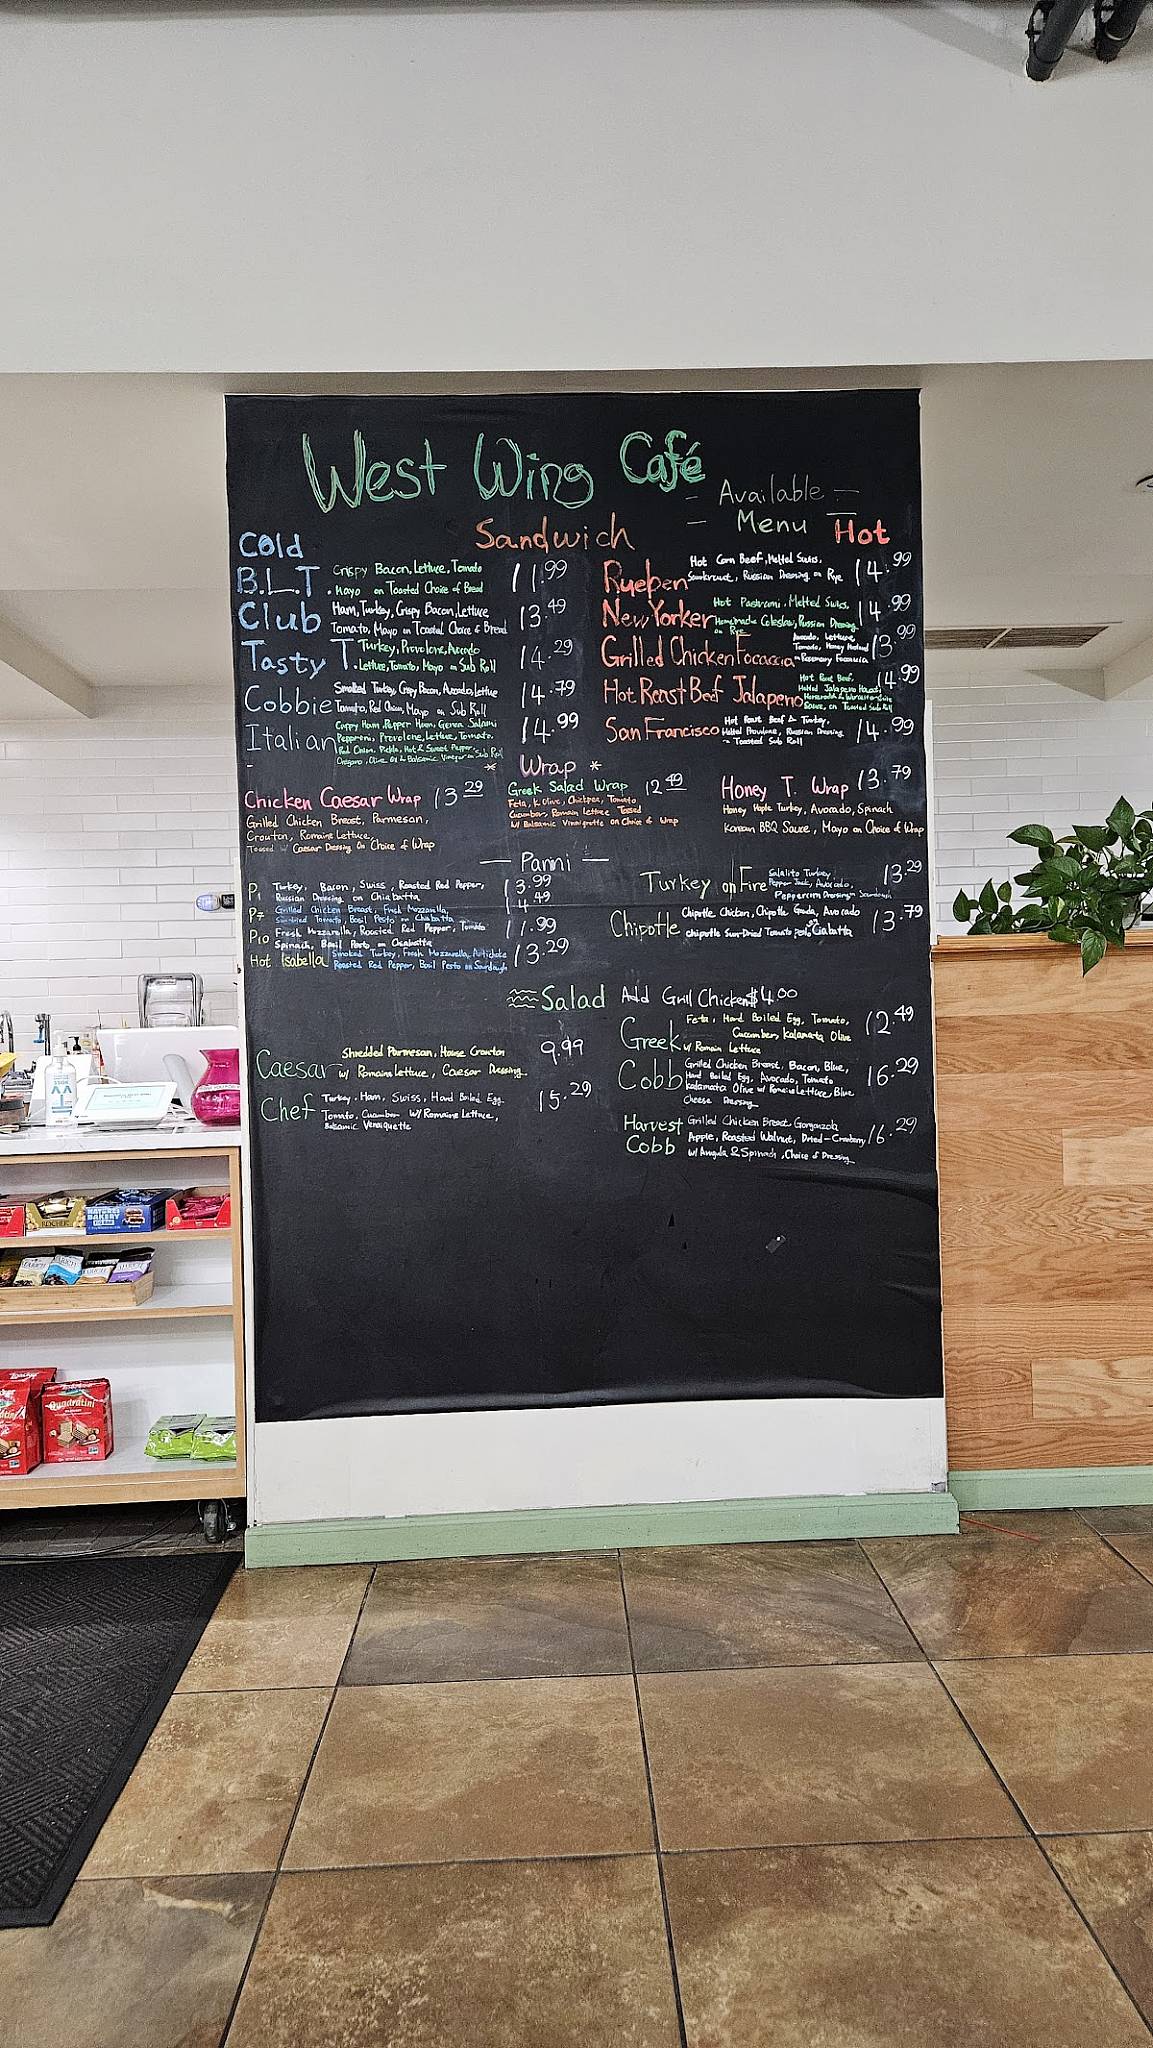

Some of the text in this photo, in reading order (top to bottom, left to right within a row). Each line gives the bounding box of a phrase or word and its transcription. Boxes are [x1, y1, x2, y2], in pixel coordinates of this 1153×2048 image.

[302, 430, 706, 513] West Wing Café
[719, 474, 825, 506] Available
[475, 511, 636, 553] Sandwich
[737, 509, 808, 534] Menu
[834, 519, 890, 545] Hot
[239, 531, 304, 558] Cold
[332, 559, 483, 580] Crispy Lettuce, Tomato
[690, 555, 708, 568] Hot
[855, 551, 912, 587] 14.99
[512, 559, 568, 593] 11.99
[827, 568, 843, 584] Rye
[335, 580, 449, 598] Mayo on Toasted Choice
[713, 594, 821, 608] Hot Melted
[238, 600, 322, 634] Club
[359, 600, 490, 620] Turkey, Crispy Lettuce
[520, 598, 567, 631] 13.49
[858, 593, 911, 627] 14.99
[330, 621, 398, 639] Tomato, Mayo
[872, 623, 916, 660] 13.99
[240, 639, 327, 680] Tasty
[357, 638, 399, 658] Turkey,
[520, 639, 573, 671] 14.29
[601, 633, 796, 668] Grilled Chicken Focaccia
[423, 657, 497, 676] Mayo Sub Roll
[877, 663, 921, 690] 14.99
[244, 684, 333, 715] Cobbie
[521, 679, 576, 709] 14.79
[603, 674, 804, 711] Hot Roast Beef Jalapeno
[369, 700, 487, 719] Red Mayo Sub Roll
[724, 715, 738, 726] Hot
[245, 723, 337, 755] Italian
[521, 711, 579, 744] 14.99
[605, 716, 720, 744] San Francisco
[856, 716, 915, 744] 14.99
[769, 736, 803, 747] Sub Roll
[519, 754, 576, 780] Wrap
[857, 765, 912, 791] 13.79
[244, 784, 423, 811] Chicken Caesar Wrap
[507, 779, 629, 797] Greek Salad Wrap
[721, 775, 767, 801] Honey
[811, 776, 850, 800] Wrap
[246, 812, 430, 829] Grilled Chicken Breast, Parmesan,
[723, 801, 894, 818] Honey Avocado, Spinach
[246, 829, 375, 842] Crouton, Romaine Lettuce,
[724, 819, 925, 837] Korean BBQ Mayo Choice Wrap
[292, 837, 435, 854] Caesar Choice Wrap
[639, 866, 768, 900] Turkey on Fire
[883, 859, 923, 886] 13.29
[275, 893, 305, 902] Russian
[319, 879, 485, 893] Bacon, Roasted Red Pepper,
[504, 873, 552, 898] 13.99
[275, 905, 341, 915] Grilled Chicken
[504, 890, 551, 915] 14.49
[681, 903, 861, 920] Chipotle Avocado
[360, 923, 416, 936] Roasted Red
[505, 916, 557, 939] 11.99
[610, 910, 680, 943] Chipotle
[872, 904, 924, 934] 13.79
[274, 940, 314, 951] Spinach,
[331, 949, 364, 958] Smoked
[513, 937, 570, 968] 13.29
[249, 951, 329, 969] Hot Isabella
[333, 960, 383, 971] Roasted Red
[541, 983, 606, 1012] Salad
[621, 984, 650, 1004] Add
[661, 984, 693, 1008] Grill
[698, 988, 750, 1009] Chicken
[723, 1012, 850, 1026] Hard Boiled Tomato,
[865, 1005, 915, 1036] 12.49
[620, 1016, 681, 1053] Greek
[830, 1029, 851, 1043] Olive
[341, 1044, 466, 1059] Shredded Parmesan, House
[540, 1038, 584, 1066] 9.99
[729, 1042, 762, 1055] Lettuce
[256, 1048, 343, 1080] Caesar
[442, 1063, 481, 1077] Caesar
[618, 1058, 683, 1091] Cobb
[684, 1057, 850, 1074] Grilled Chicken Bacon, Blue,
[867, 1057, 919, 1087] 16.29
[260, 1093, 317, 1122] Chef
[391, 1091, 453, 1103] Swiss, Hard
[539, 1080, 592, 1112] 15.29
[623, 1113, 684, 1136] Harvest
[687, 1114, 759, 1127] Grilled Chicken
[867, 1117, 918, 1145] 16.29
[626, 1134, 676, 1156] Cobb
[688, 1130, 756, 1143] Apple, Roasted
